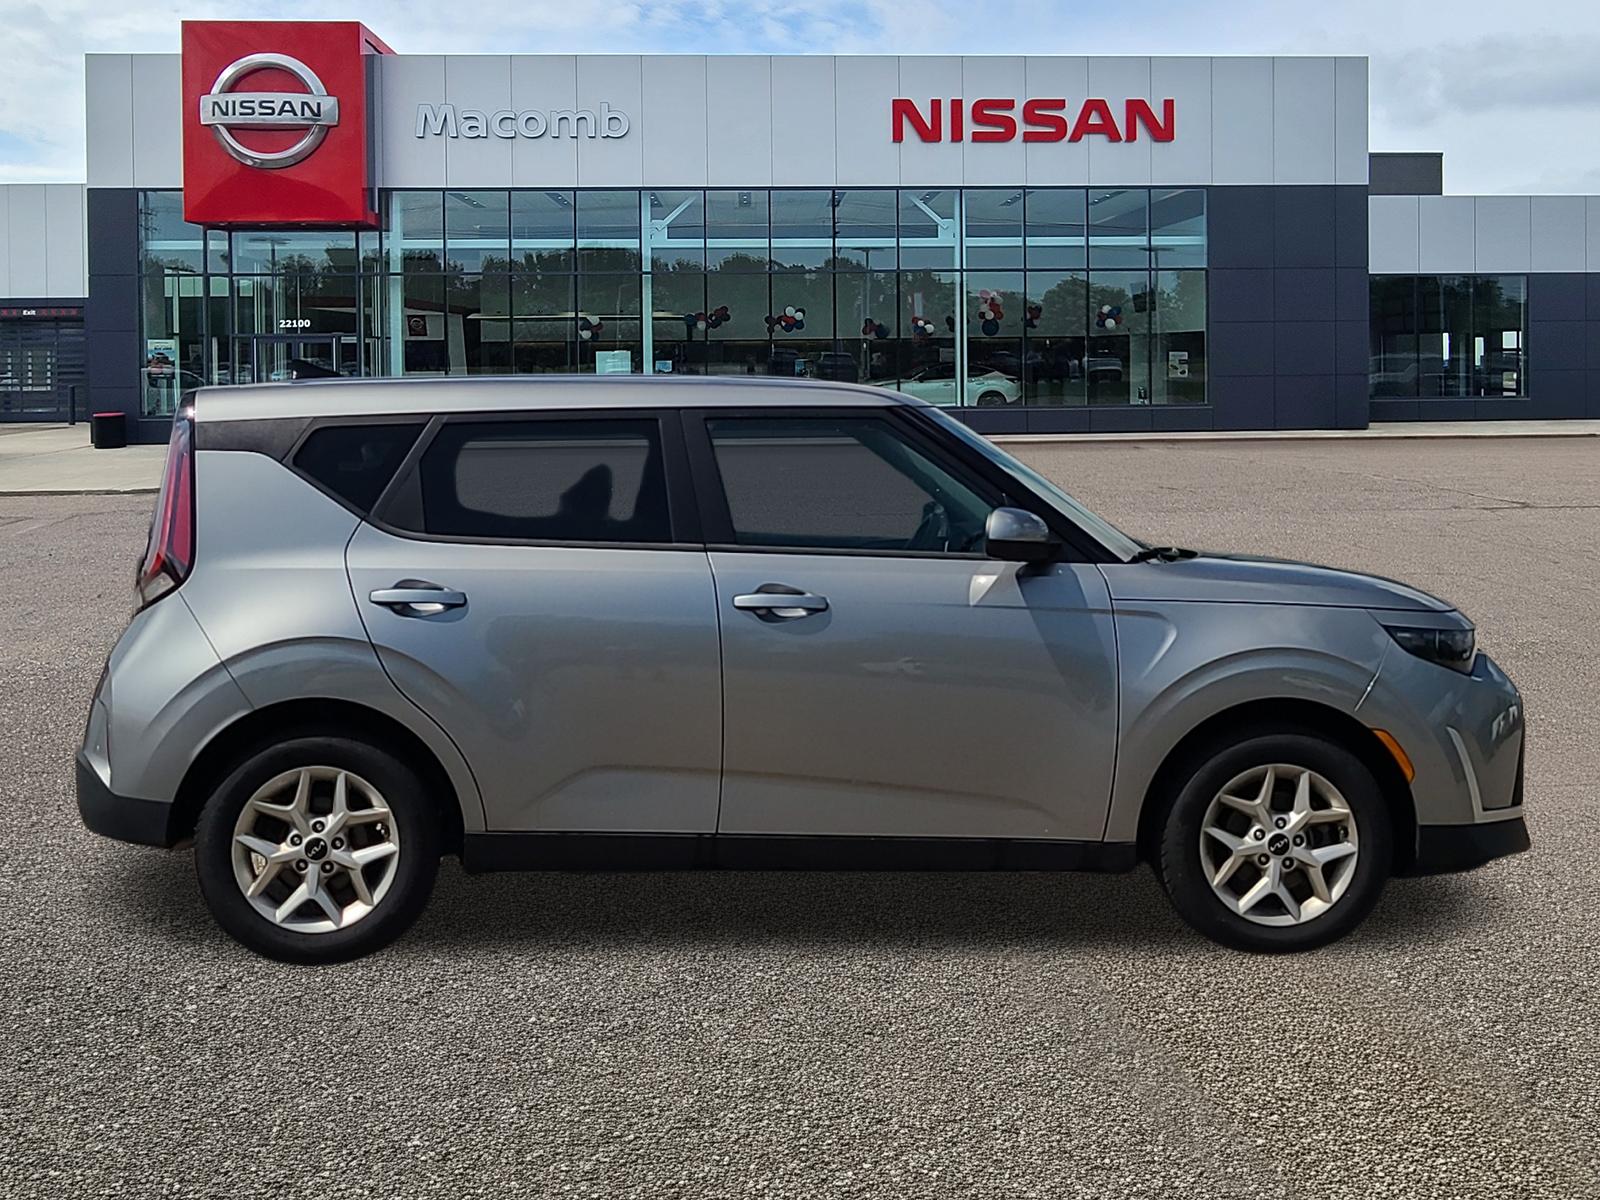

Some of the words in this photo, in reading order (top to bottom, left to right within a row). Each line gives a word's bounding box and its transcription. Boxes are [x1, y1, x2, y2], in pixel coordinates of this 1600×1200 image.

[212, 100, 322, 117] NISSAN
[415, 102, 630, 139] Macomb
[892, 98, 1175, 143] NISSAN
[279, 319, 311, 328] 22100
